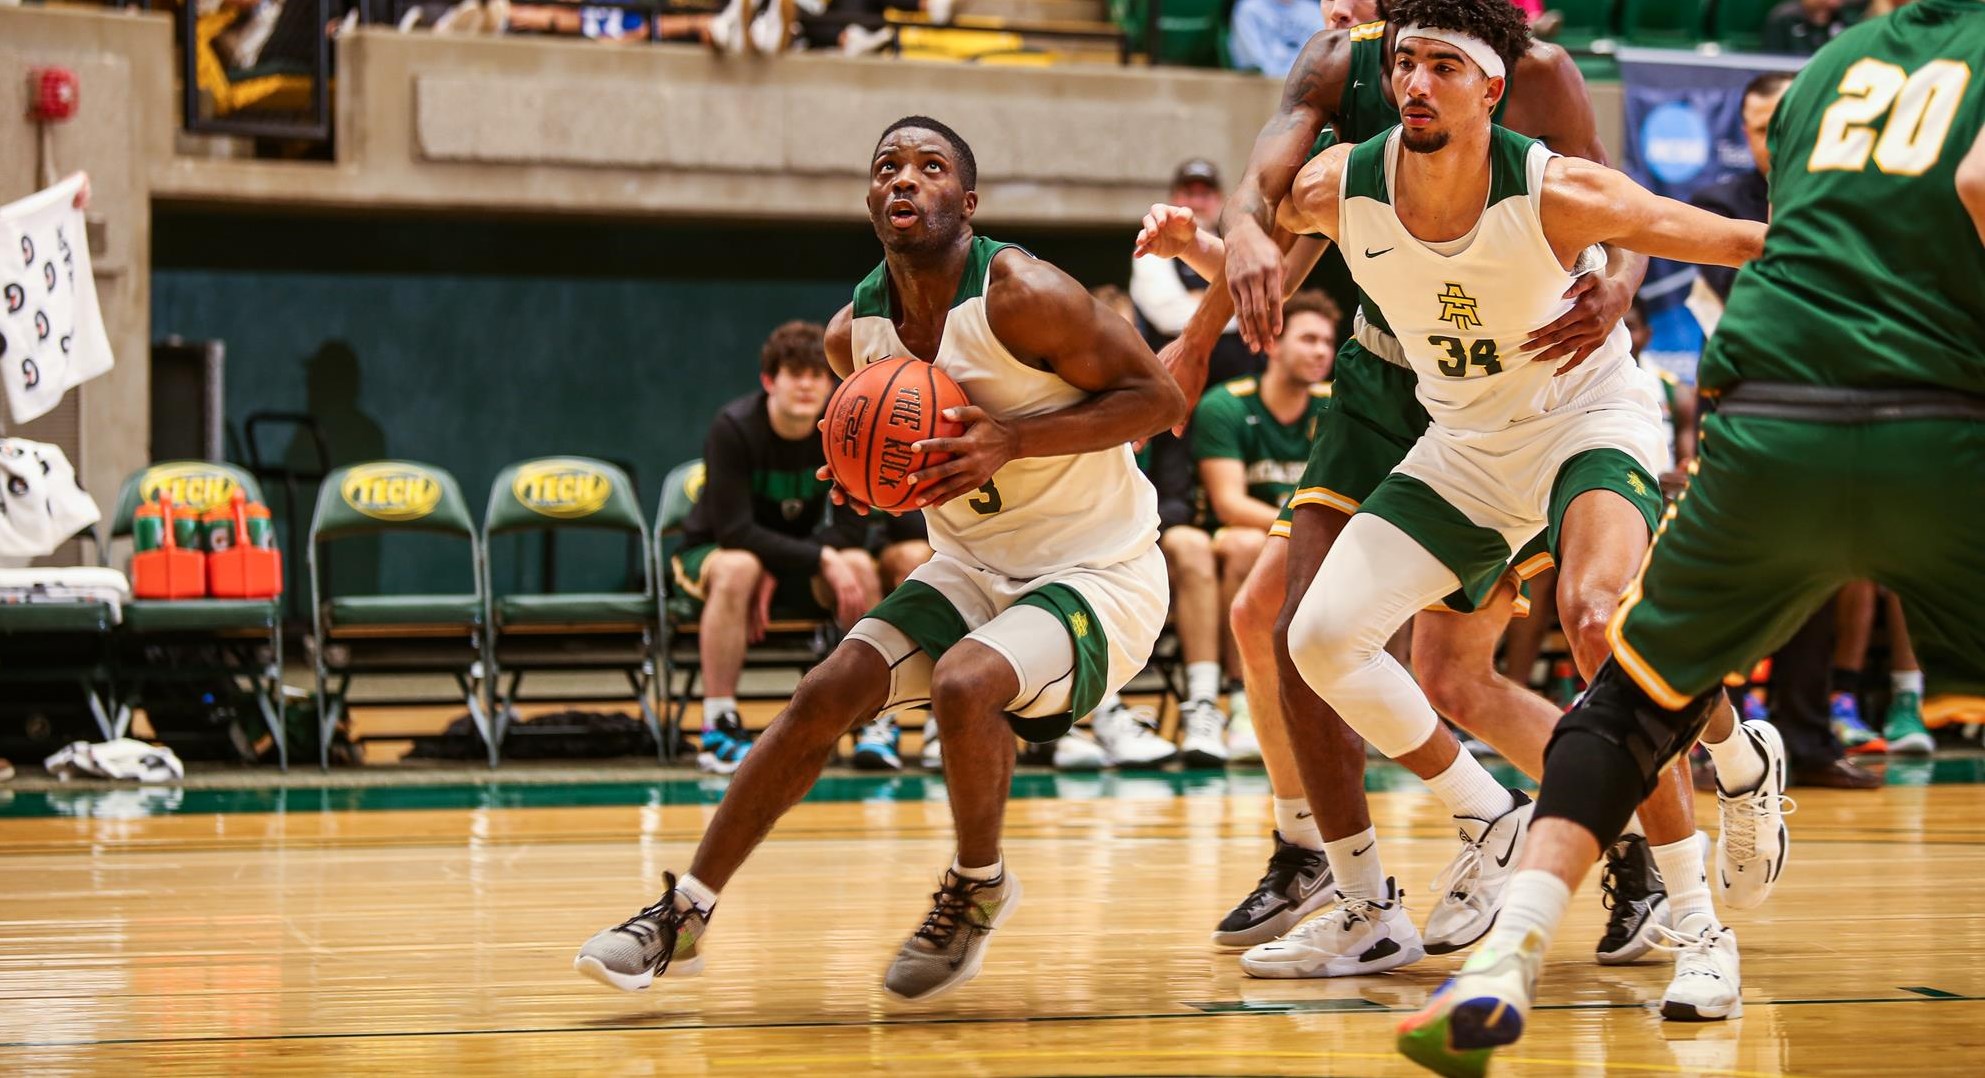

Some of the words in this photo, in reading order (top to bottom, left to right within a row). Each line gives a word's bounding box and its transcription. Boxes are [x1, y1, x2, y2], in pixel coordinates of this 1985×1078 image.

[1807, 57, 1971, 176] 20
[1428, 335, 1503, 377] 34
[889, 387, 922, 432] THE
[878, 437, 914, 489] ROCK
